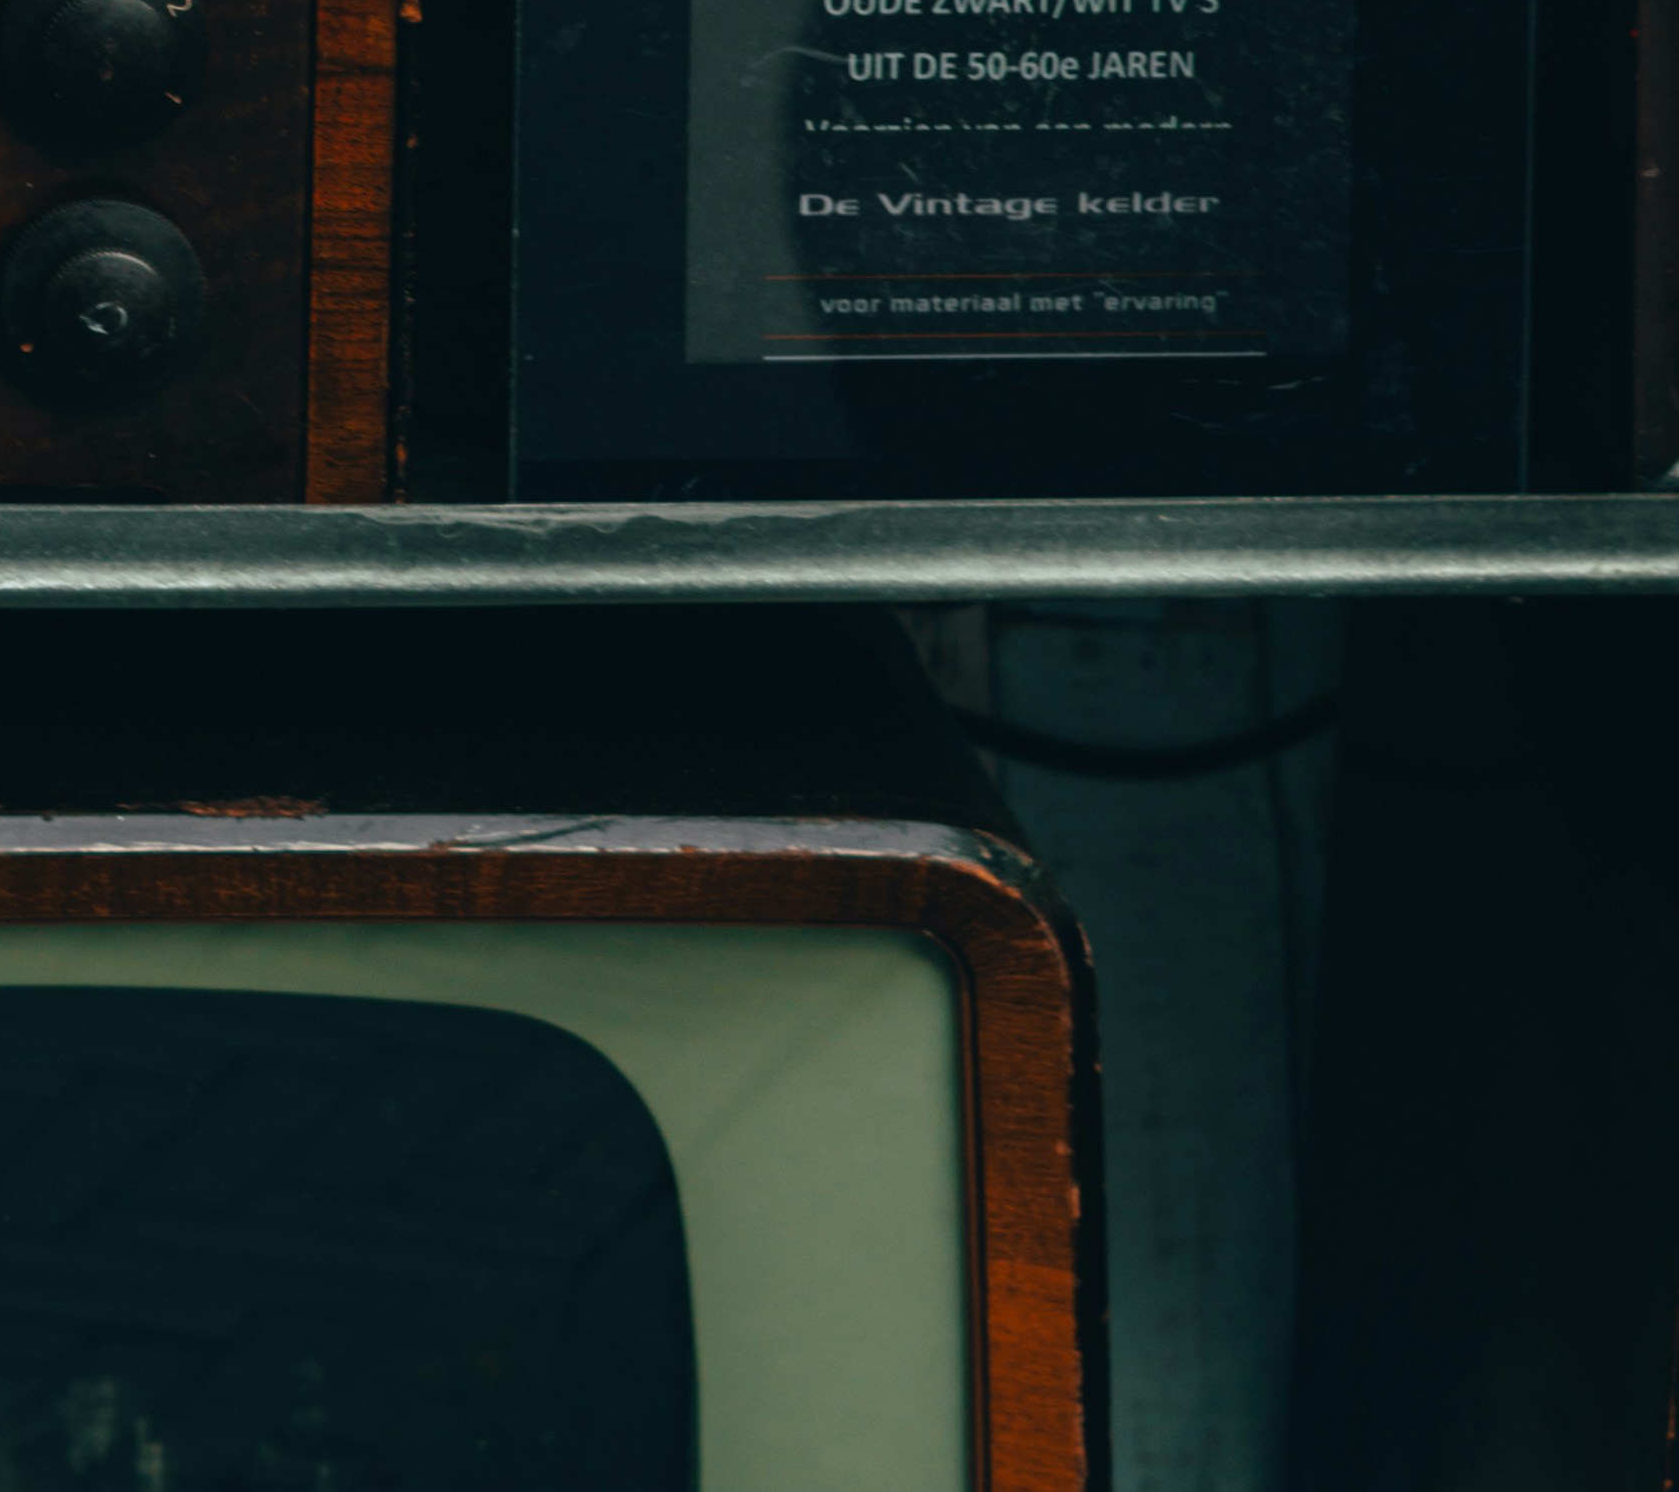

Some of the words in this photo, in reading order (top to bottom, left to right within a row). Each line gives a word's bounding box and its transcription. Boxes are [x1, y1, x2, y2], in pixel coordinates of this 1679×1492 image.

[847, 50, 906, 83] UIT
[913, 52, 957, 80] DE
[967, 51, 1079, 81] 50-60e
[1087, 51, 1194, 80] JAREN
[799, 194, 858, 216] De
[878, 193, 1057, 221] Vintage
[1078, 191, 1219, 214] kelder
[820, 298, 881, 314] voor
[890, 293, 1021, 313] materiaal
[1030, 294, 1083, 312] met
